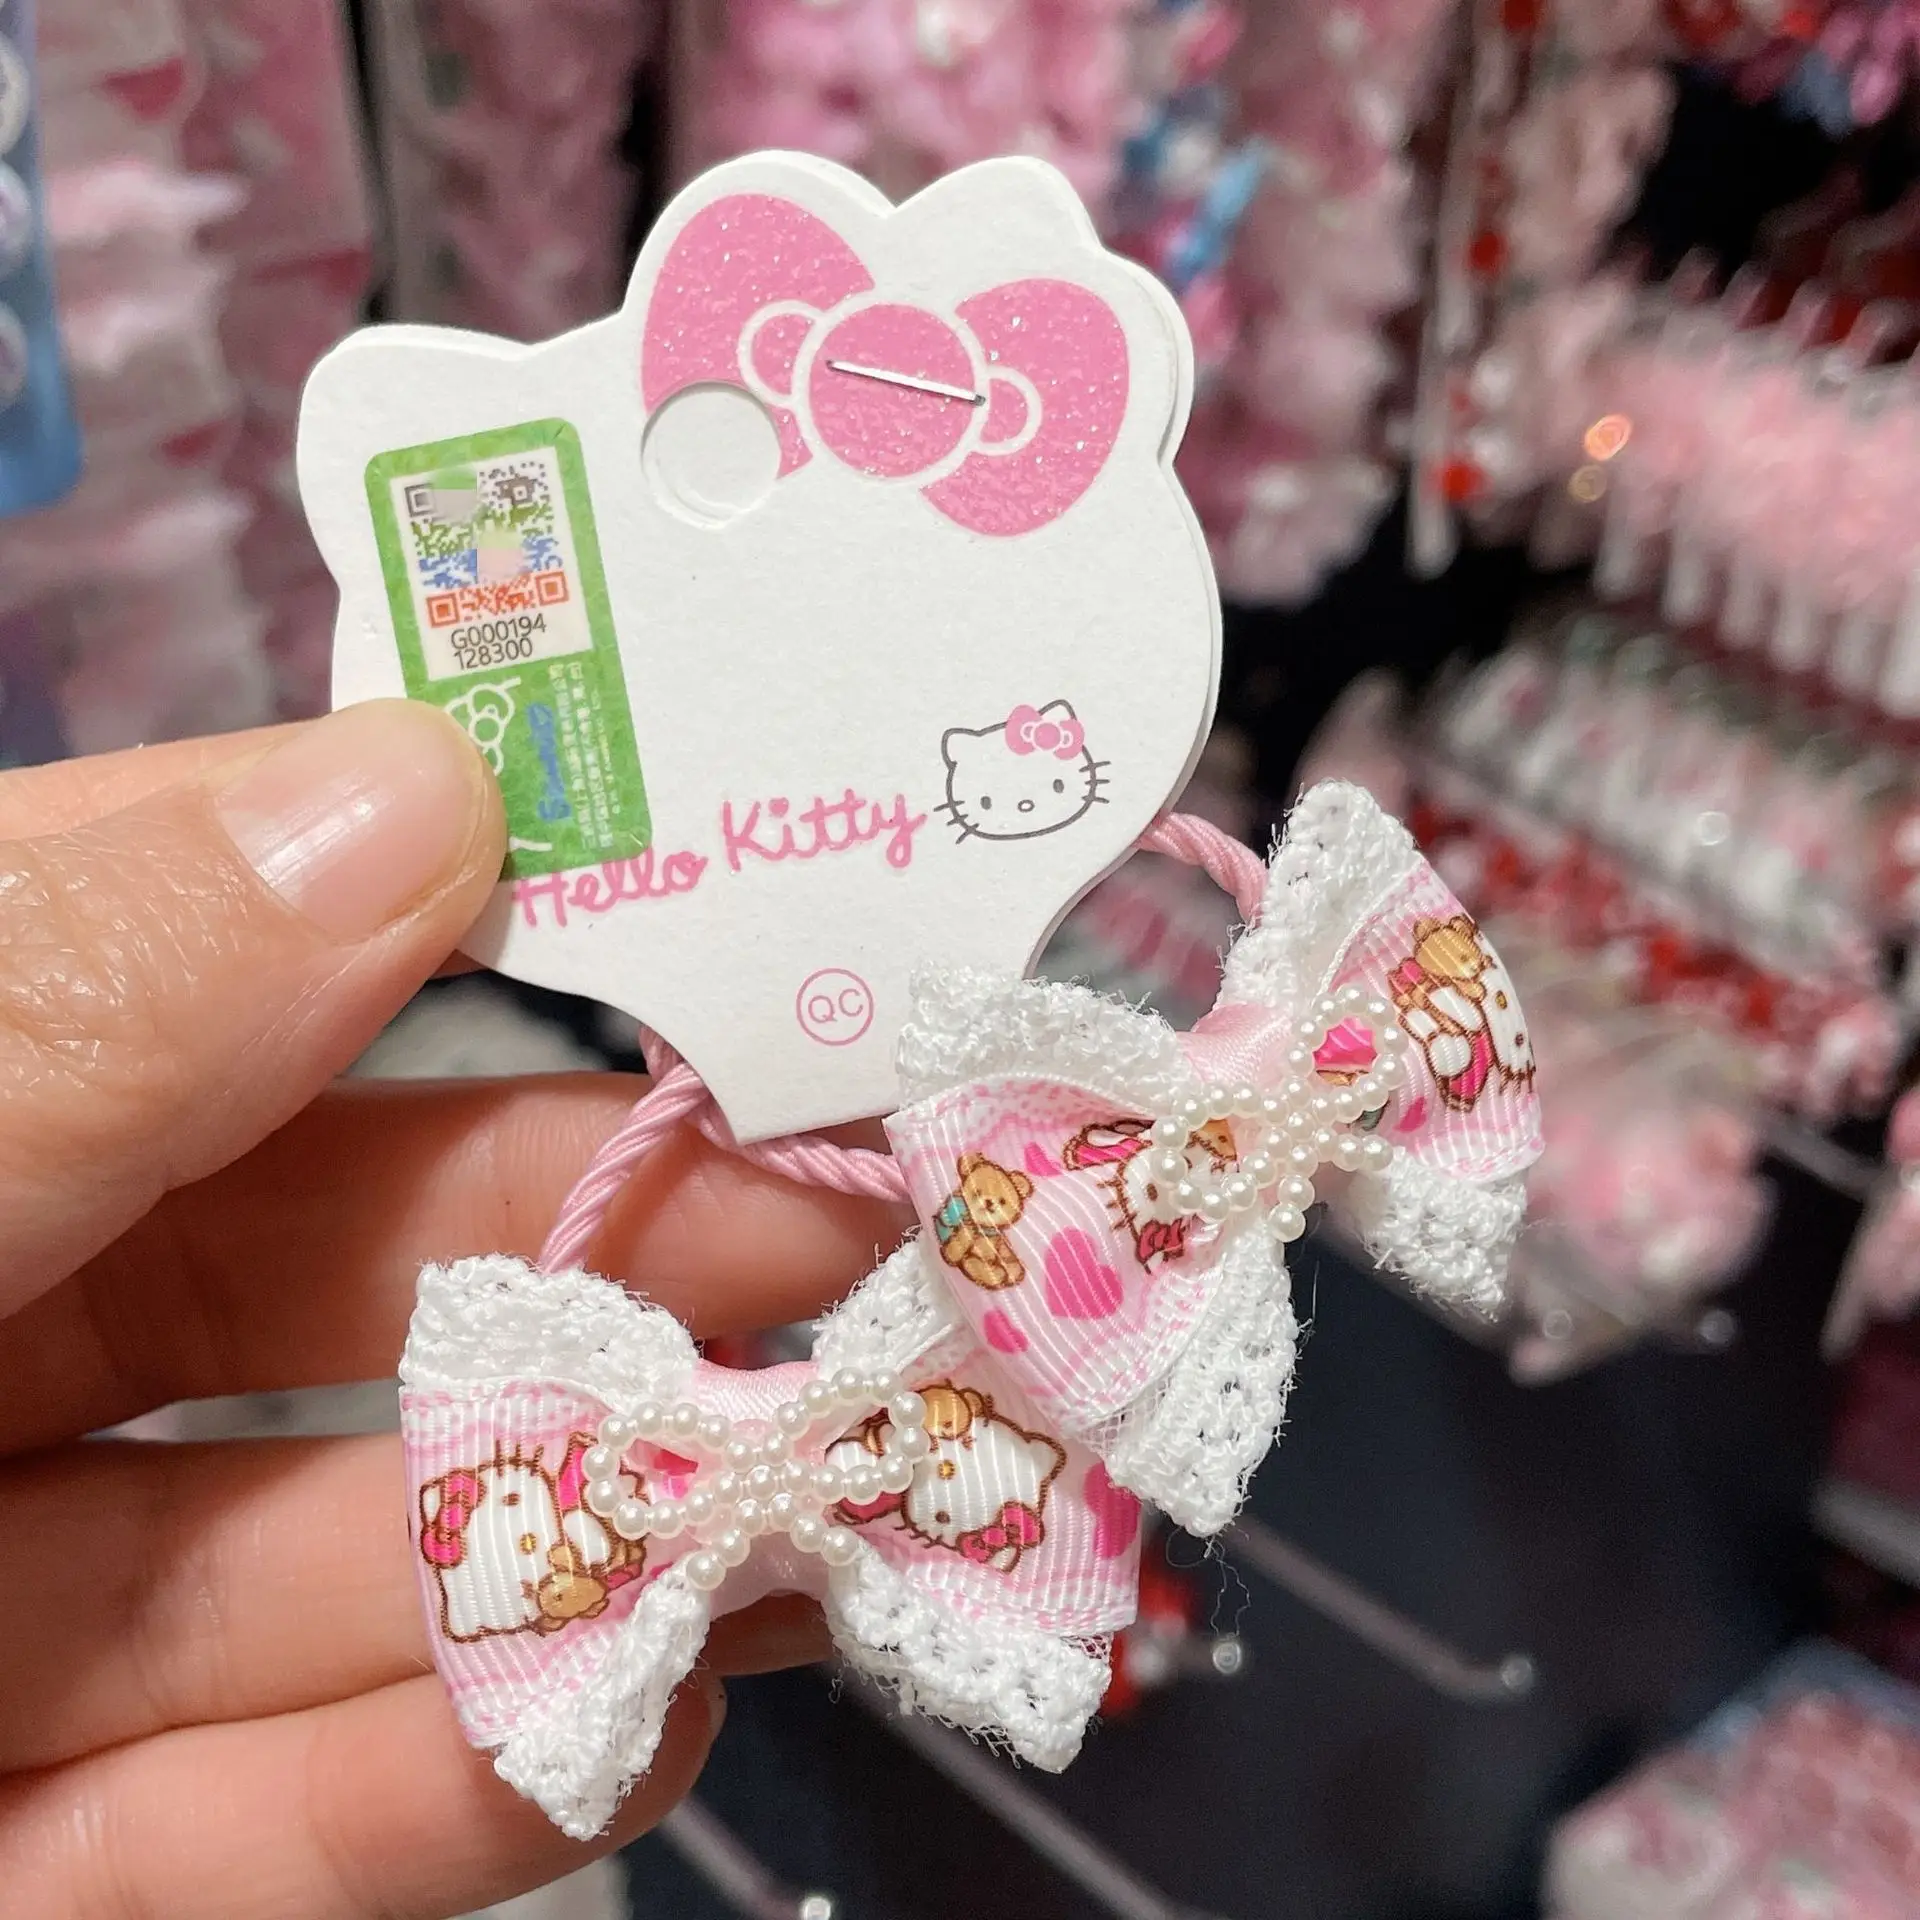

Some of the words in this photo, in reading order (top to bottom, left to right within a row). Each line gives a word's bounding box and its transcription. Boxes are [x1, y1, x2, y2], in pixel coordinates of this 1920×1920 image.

[450, 612, 547, 650] G000194
[454, 637, 534, 670] 128300
[513, 846, 708, 928] Hello
[721, 788, 928, 872] Kitty
[807, 988, 864, 1024] QC
